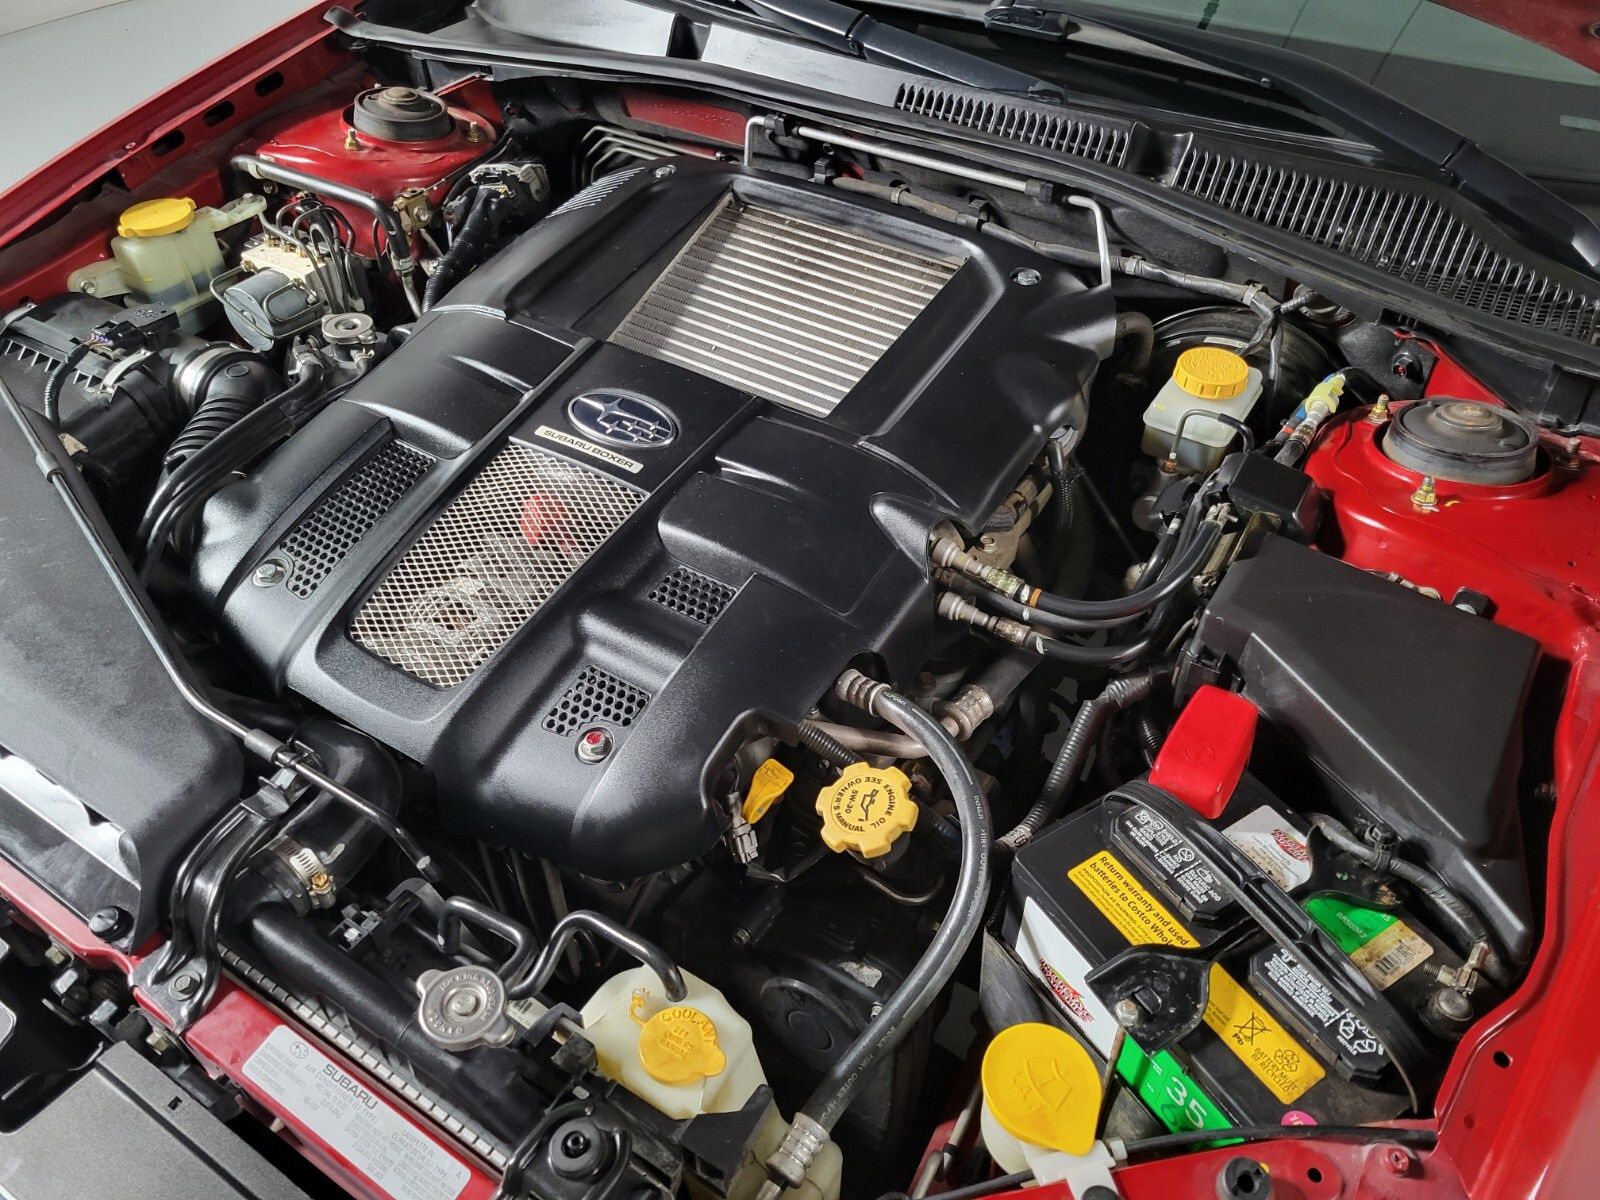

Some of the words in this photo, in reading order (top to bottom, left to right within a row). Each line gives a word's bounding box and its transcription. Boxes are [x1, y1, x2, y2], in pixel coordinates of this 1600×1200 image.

[543, 430, 592, 451] SUBARU
[592, 446, 634, 469] BOXER
[833, 777, 862, 811] OWNER'S
[865, 776, 883, 785] SEE
[845, 789, 859, 814] 5W-30
[883, 784, 896, 817] ENGINE
[972, 794, 985, 819] INNER
[834, 812, 866, 833] MANUAL
[870, 817, 886, 829] OIL
[977, 852, 986, 882] OUTER
[1090, 862, 1121, 894] batteries
[1119, 892, 1129, 902] to
[1128, 901, 1151, 925] Costco
[1099, 856, 1125, 881] Return
[1123, 880, 1155, 913] warranty
[1153, 911, 1171, 927] and
[1168, 926, 1190, 946] used
[661, 1008, 716, 1043] COOLANT
[673, 1026, 690, 1039] SEE
[1232, 1033, 1244, 1045] Pb
[661, 1037, 688, 1059] MANUAL
[1251, 1053, 1260, 1062] BE
[1260, 1061, 1291, 1092] RECYCLED
[1255, 1047, 1279, 1072] BATTERY
[1279, 1071, 1298, 1090] MUST
[323, 1063, 378, 1110] SUBARU
[835, 1070, 858, 1099] OUTER
[1166, 1076, 1208, 1128] 35
